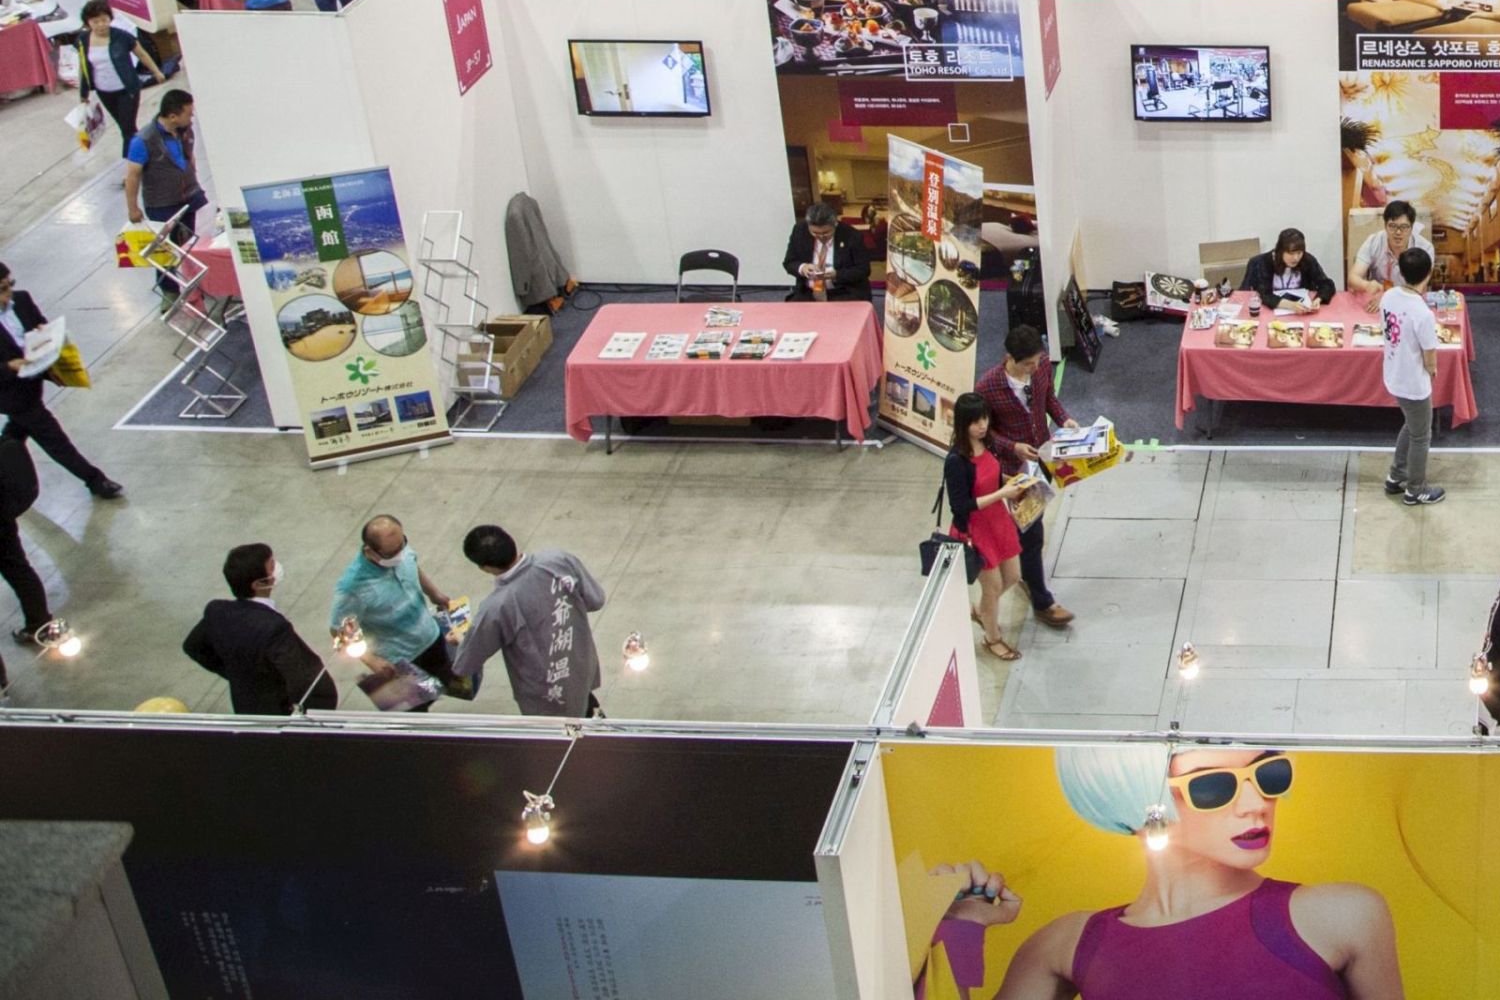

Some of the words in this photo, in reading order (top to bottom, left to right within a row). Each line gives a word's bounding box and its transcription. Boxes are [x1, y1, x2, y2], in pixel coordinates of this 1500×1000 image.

[455, 5, 478, 35] JAPAN
[909, 49, 941, 66] 토호
[1361, 40, 1427, 57] 르네상스
[1432, 40, 1481, 57] 삿포로
[465, 49, 482, 73] JP-57
[910, 66, 937, 76] TOHO
[1361, 59, 1426, 68] RENAISSANCE
[1428, 59, 1473, 68] SAPPORO
[927, 171, 941, 237] 登別温泉
[314, 203, 341, 248] 函館
